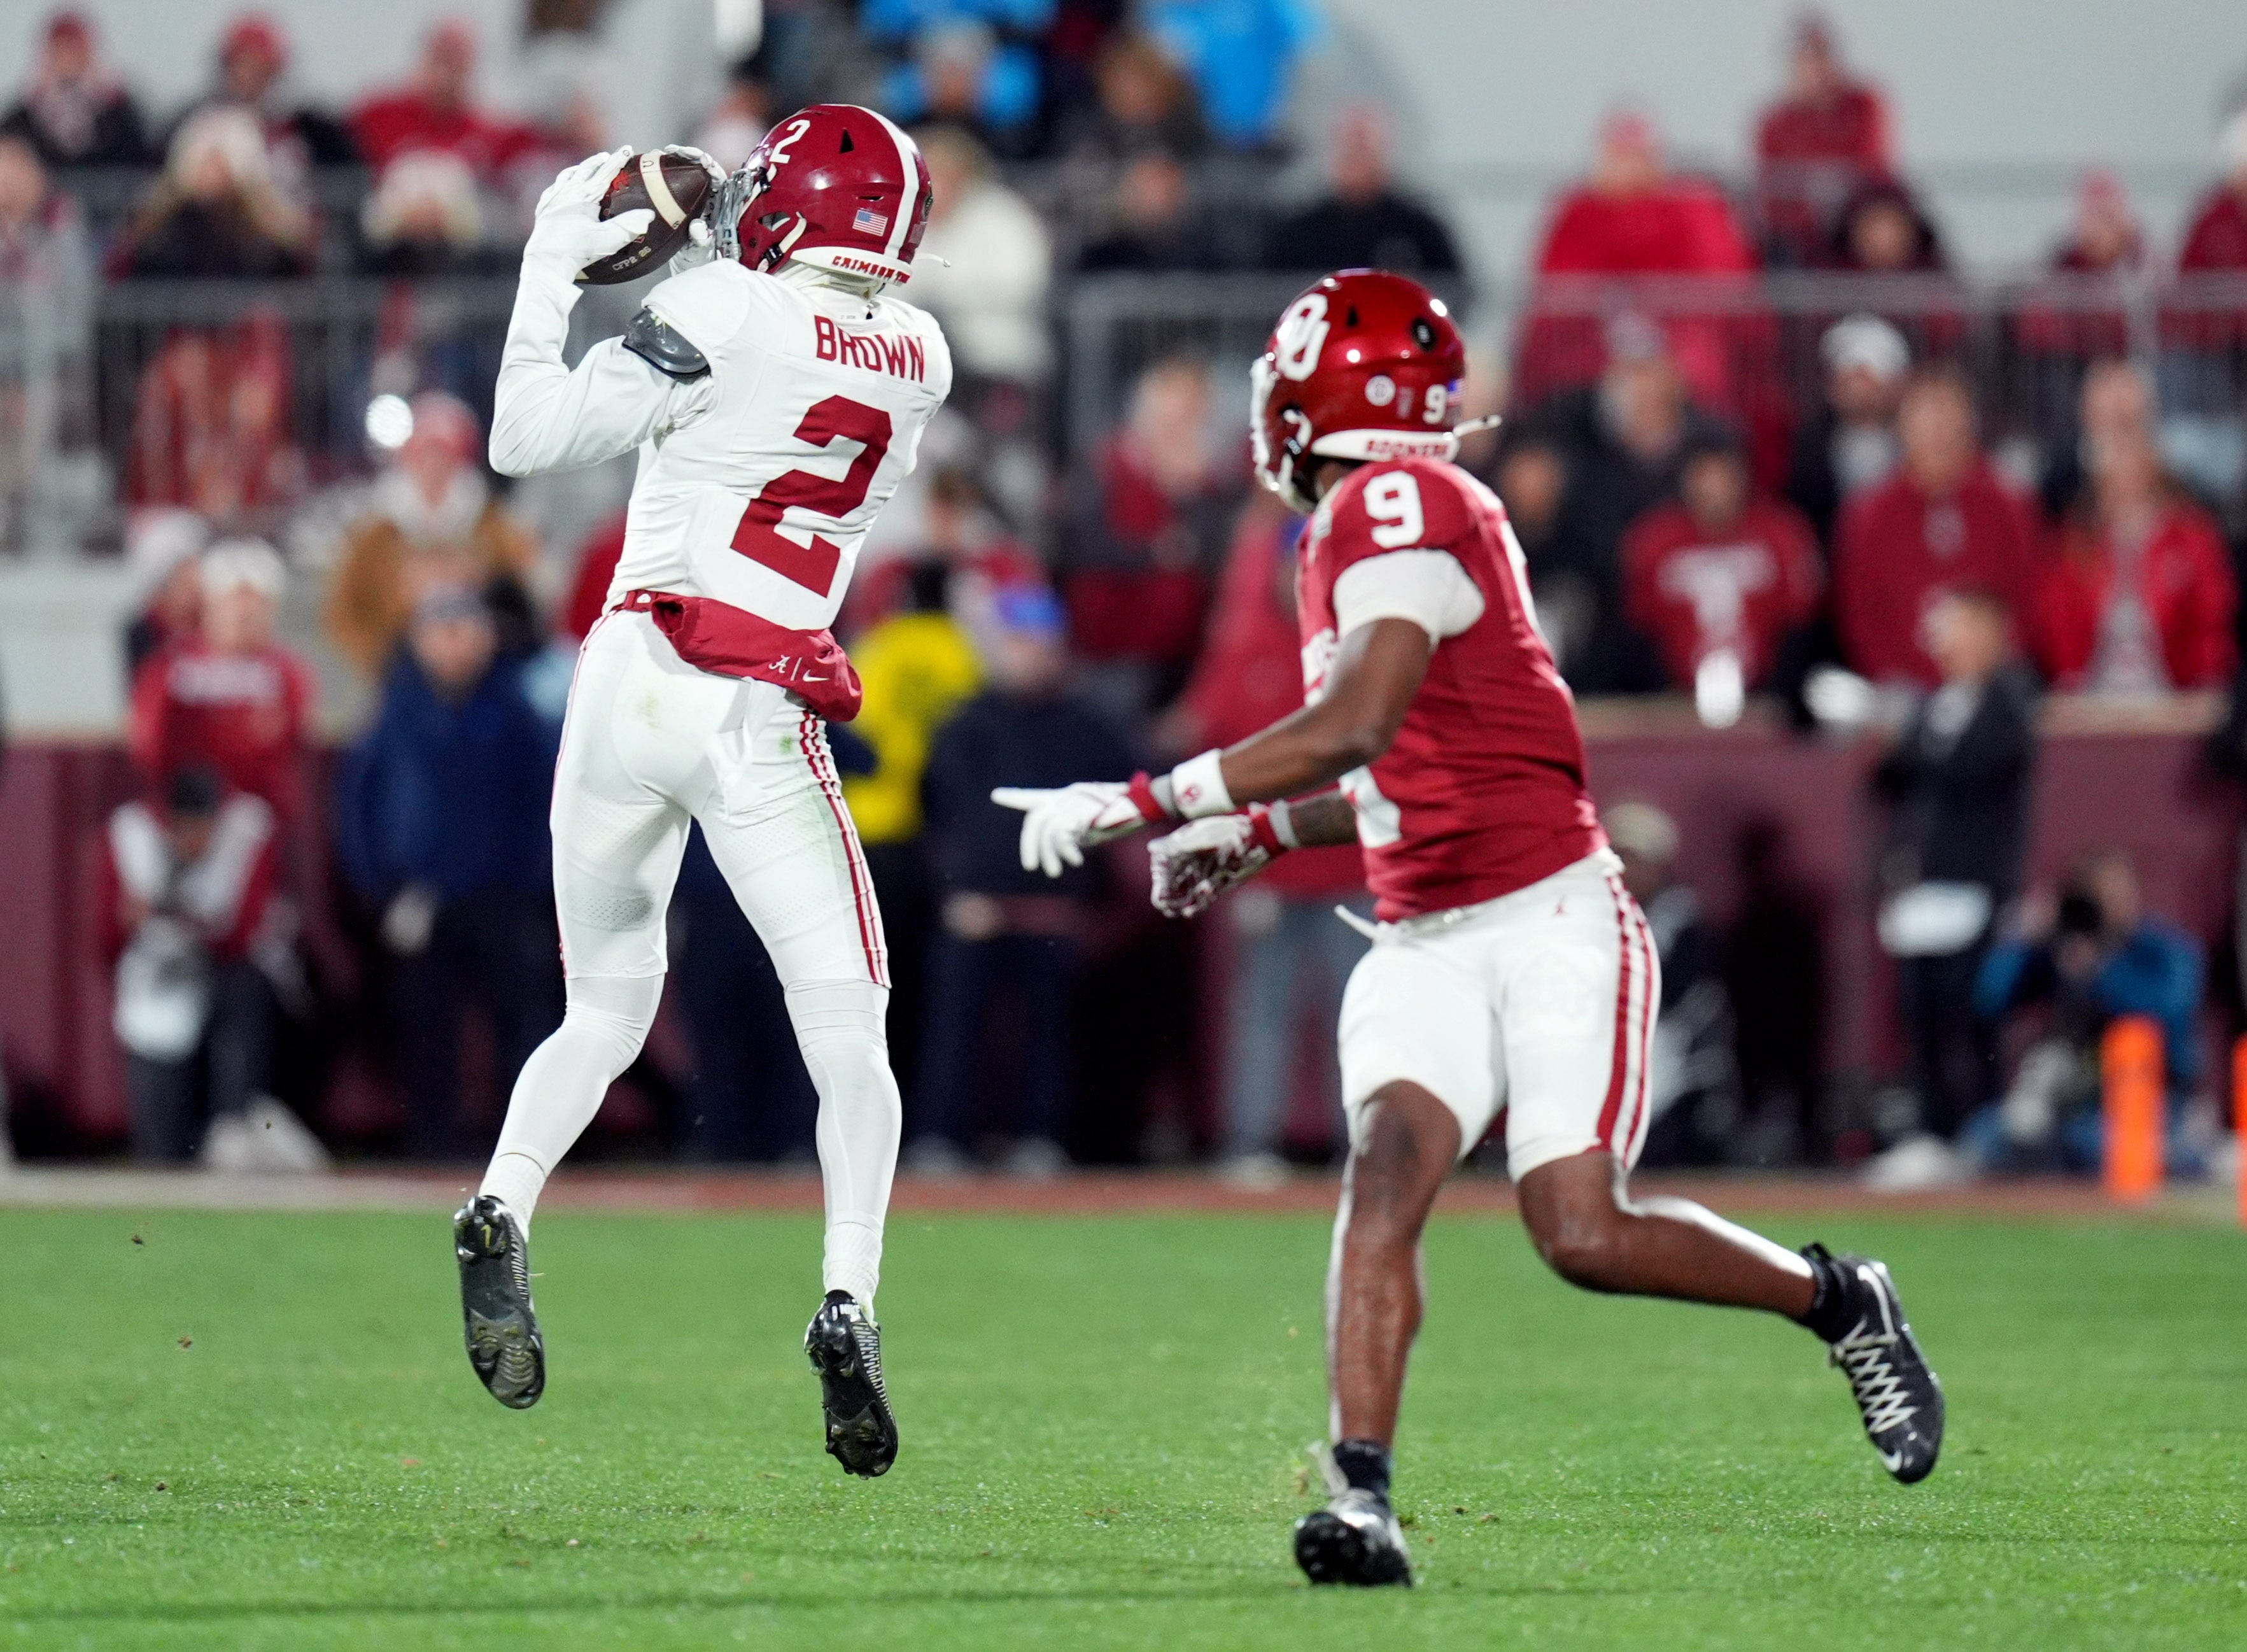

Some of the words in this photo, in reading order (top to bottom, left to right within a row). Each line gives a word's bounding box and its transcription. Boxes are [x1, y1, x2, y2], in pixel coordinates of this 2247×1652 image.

[769, 119, 811, 164] 2
[814, 314, 924, 383] BROWN
[1422, 384, 1448, 425] 9
[729, 394, 893, 598] 2
[1363, 470, 1424, 549] 9
